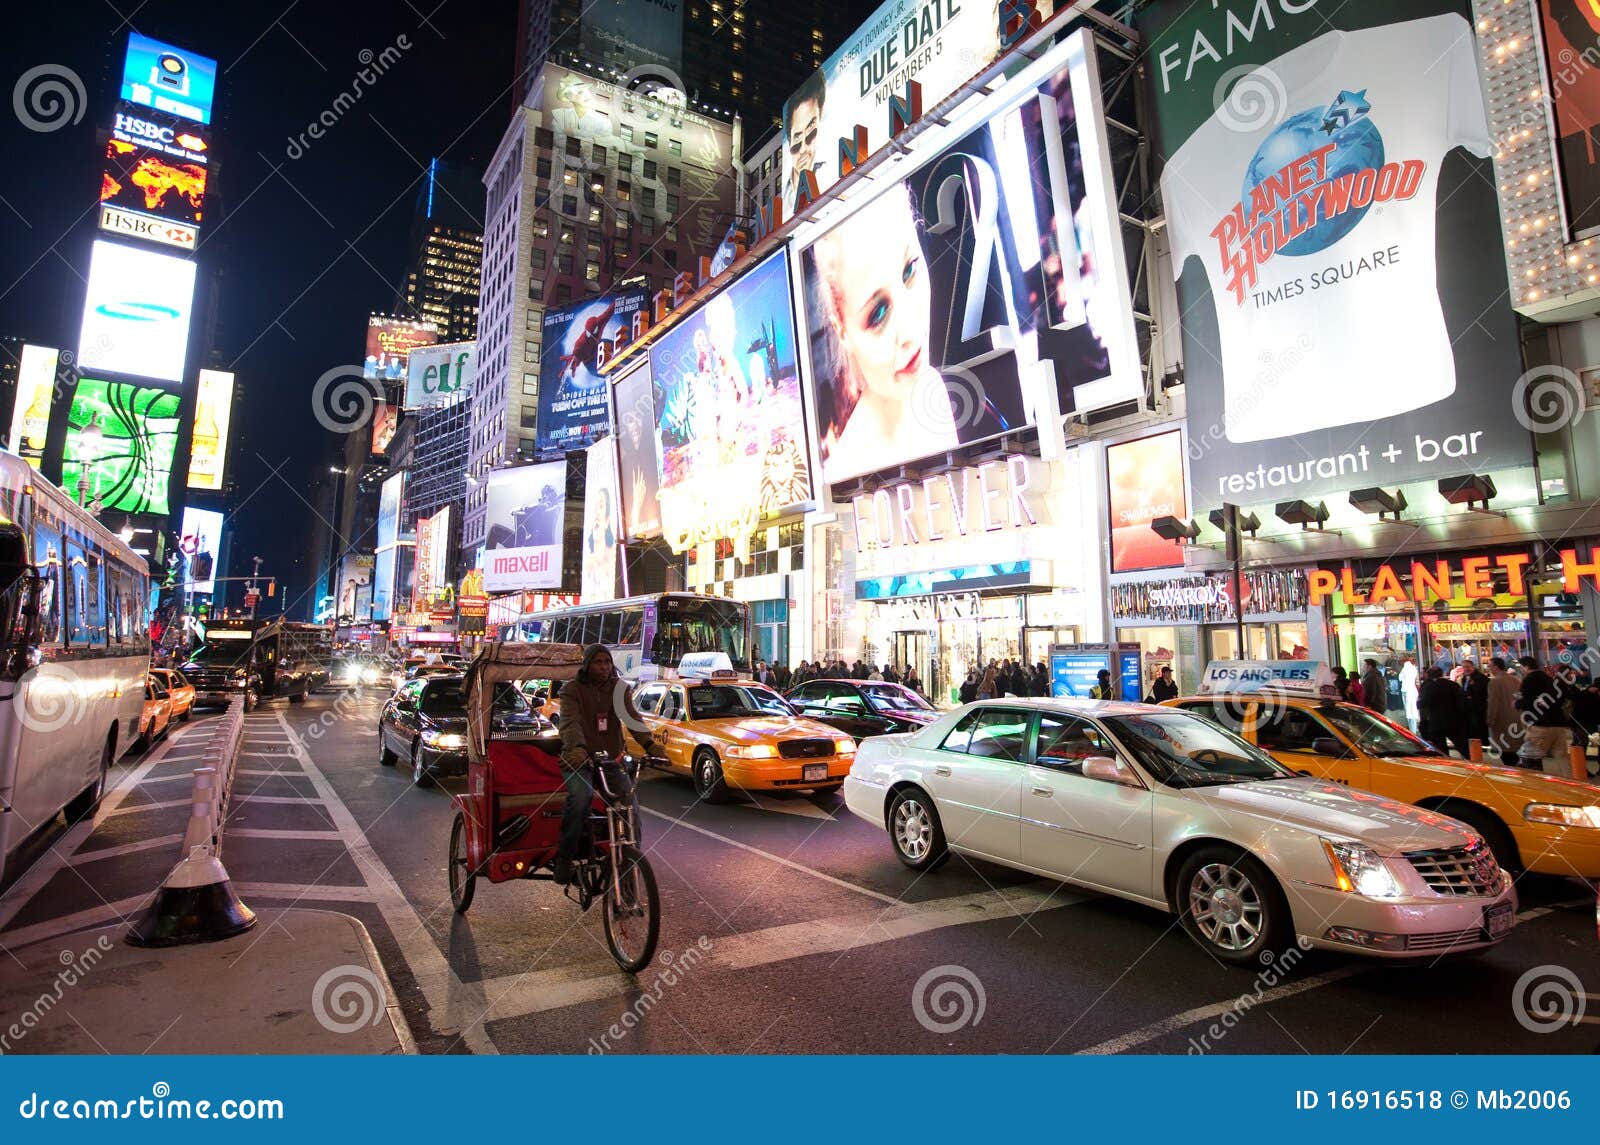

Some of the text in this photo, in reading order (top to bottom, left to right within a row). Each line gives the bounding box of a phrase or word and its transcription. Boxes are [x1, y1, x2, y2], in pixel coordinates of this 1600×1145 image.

[865, 14, 893, 47] DOWNEY
[860, 33, 898, 98] DUE
[875, 36, 943, 107] NOVEMBER 5
[114, 113, 175, 143] HSBC
[105, 211, 162, 236] HSBC
[1209, 143, 1337, 274] PLANET
[1226, 159, 1427, 307] HOLLYWOOD
[1253, 245, 1400, 308] TIMES SQUARE
[421, 352, 470, 394] elf
[1218, 444, 1370, 495] restaurant
[1416, 430, 1484, 462] bar
[852, 452, 1037, 553] FOREVER
[494, 551, 549, 574] maxell
[1307, 553, 1530, 606] PLANET
[1428, 621, 1526, 633] RESTAURANT & BAR
[1211, 669, 1310, 681] LOS ANGELES
